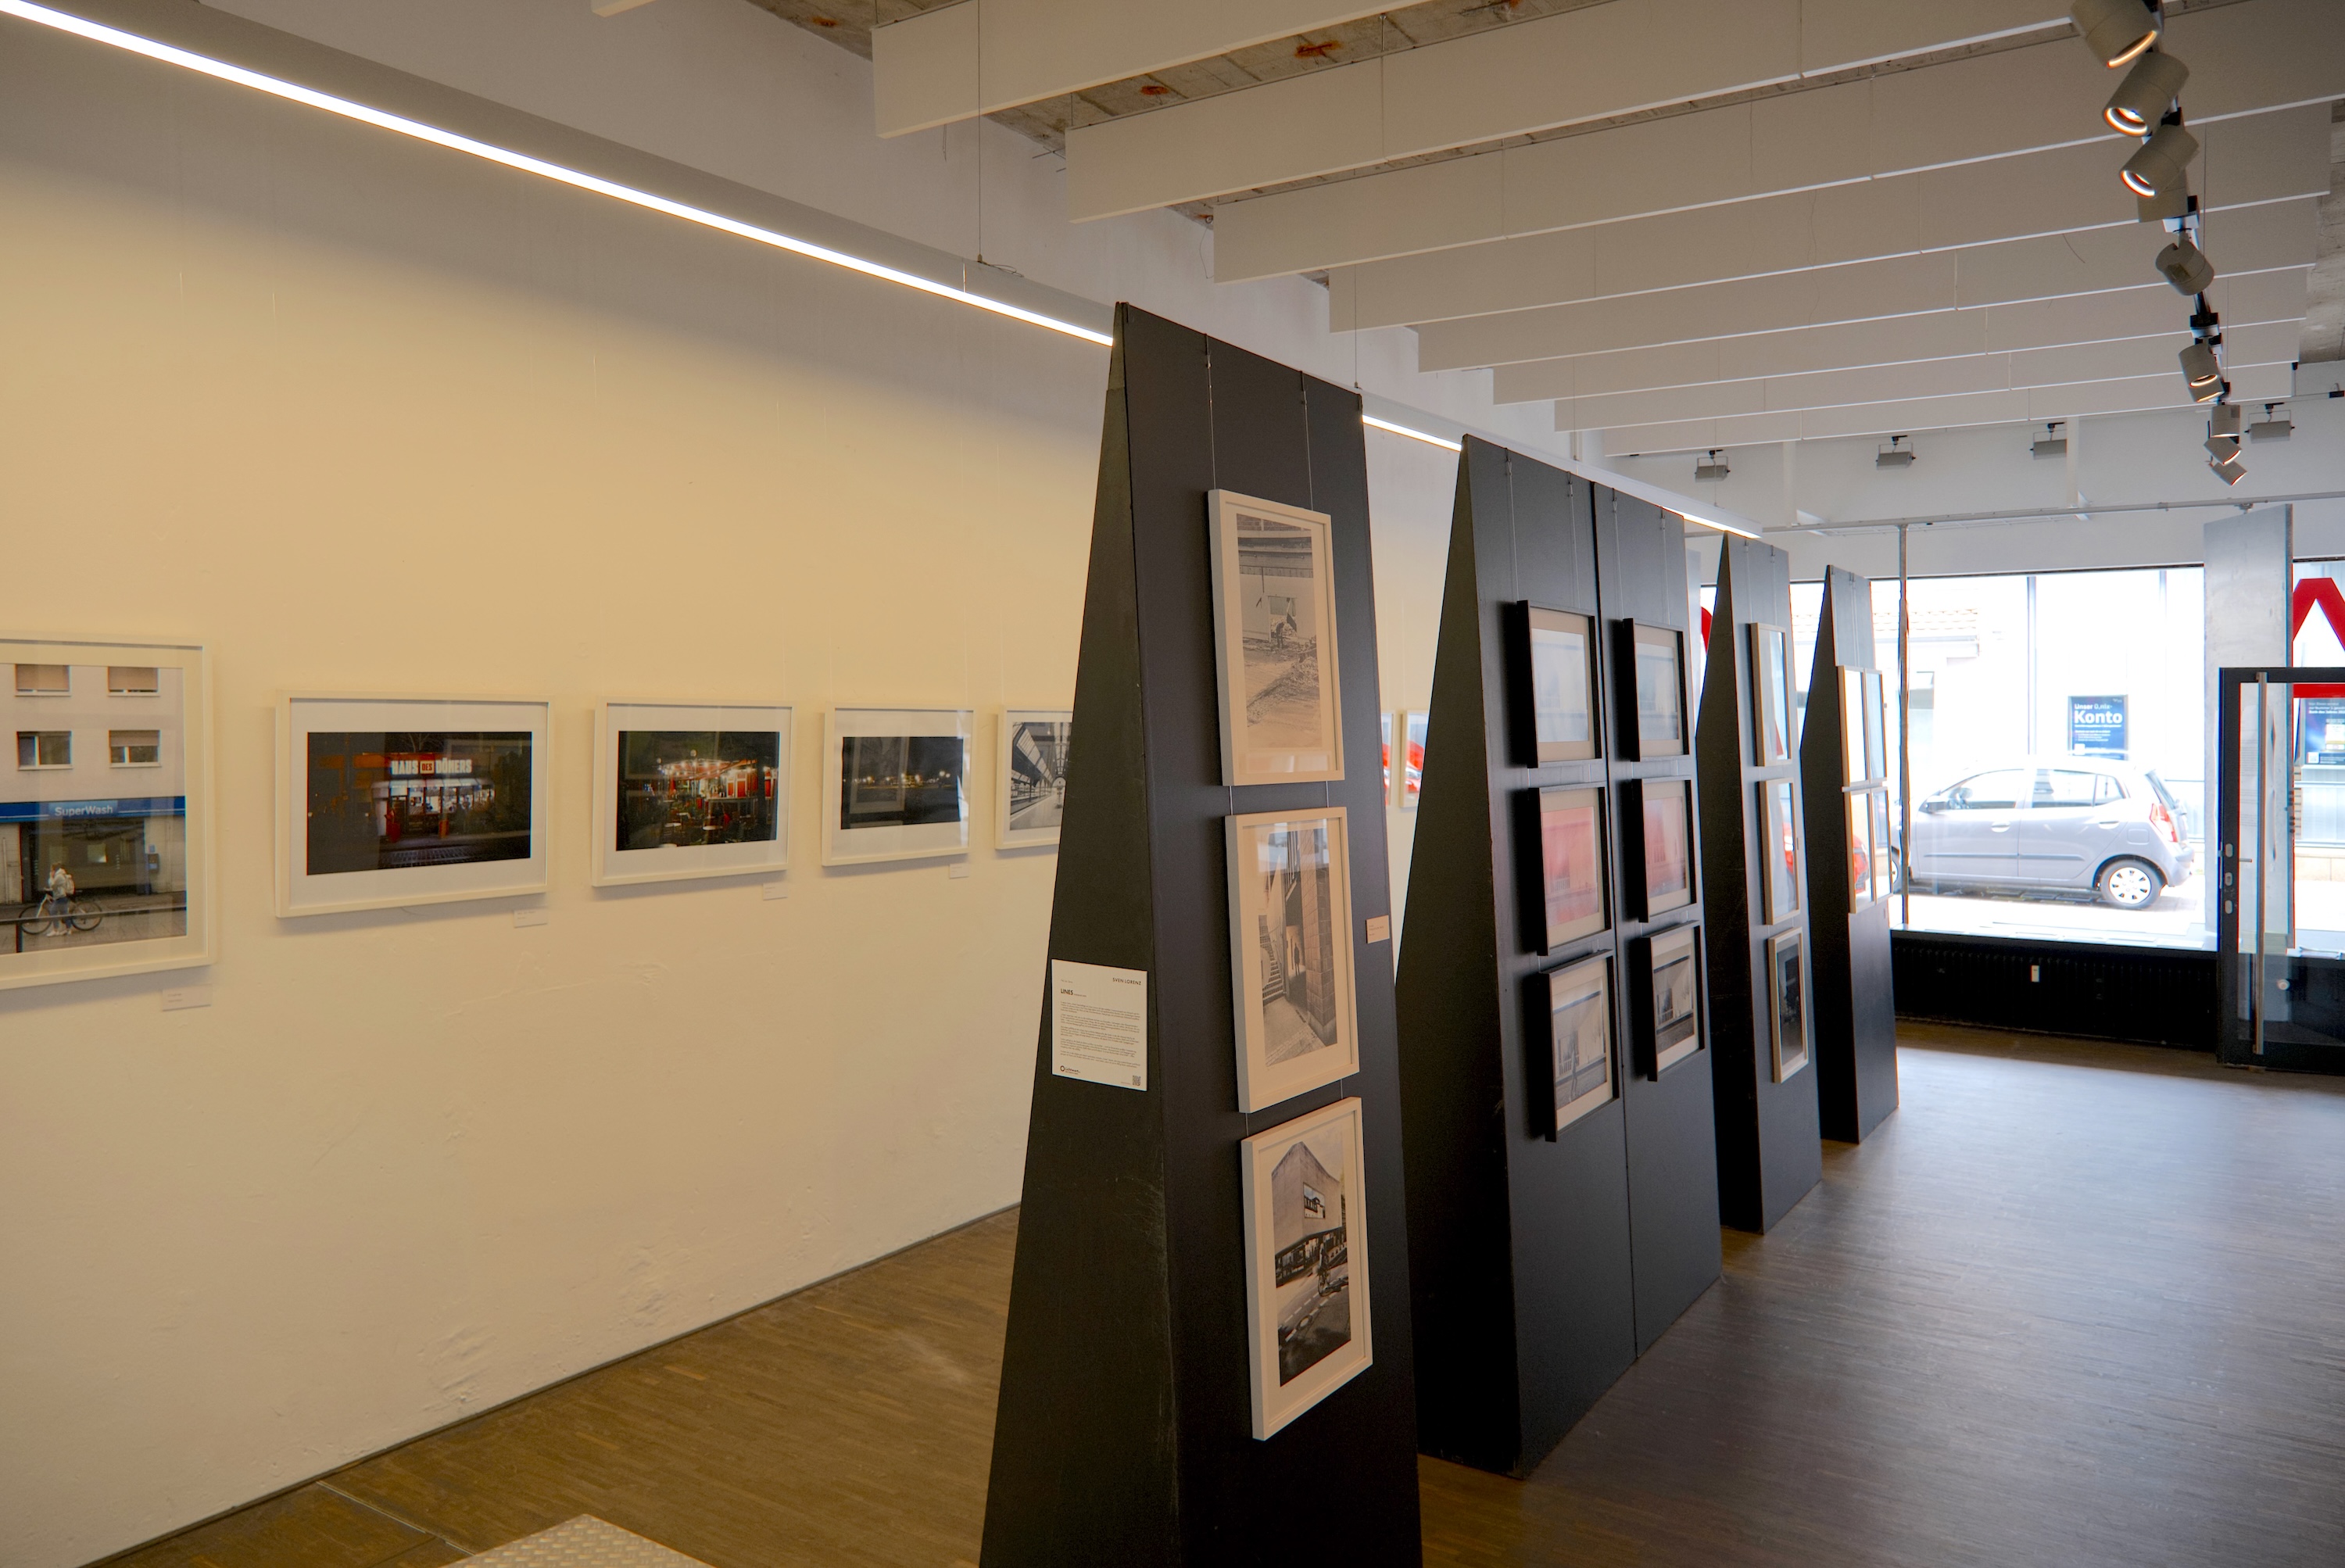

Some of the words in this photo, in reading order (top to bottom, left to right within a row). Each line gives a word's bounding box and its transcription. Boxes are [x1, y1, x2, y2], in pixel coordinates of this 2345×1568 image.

[2074, 710, 2123, 724] Konto
[392, 760, 418, 775] HAUS
[55, 805, 113, 817] SuperWash
